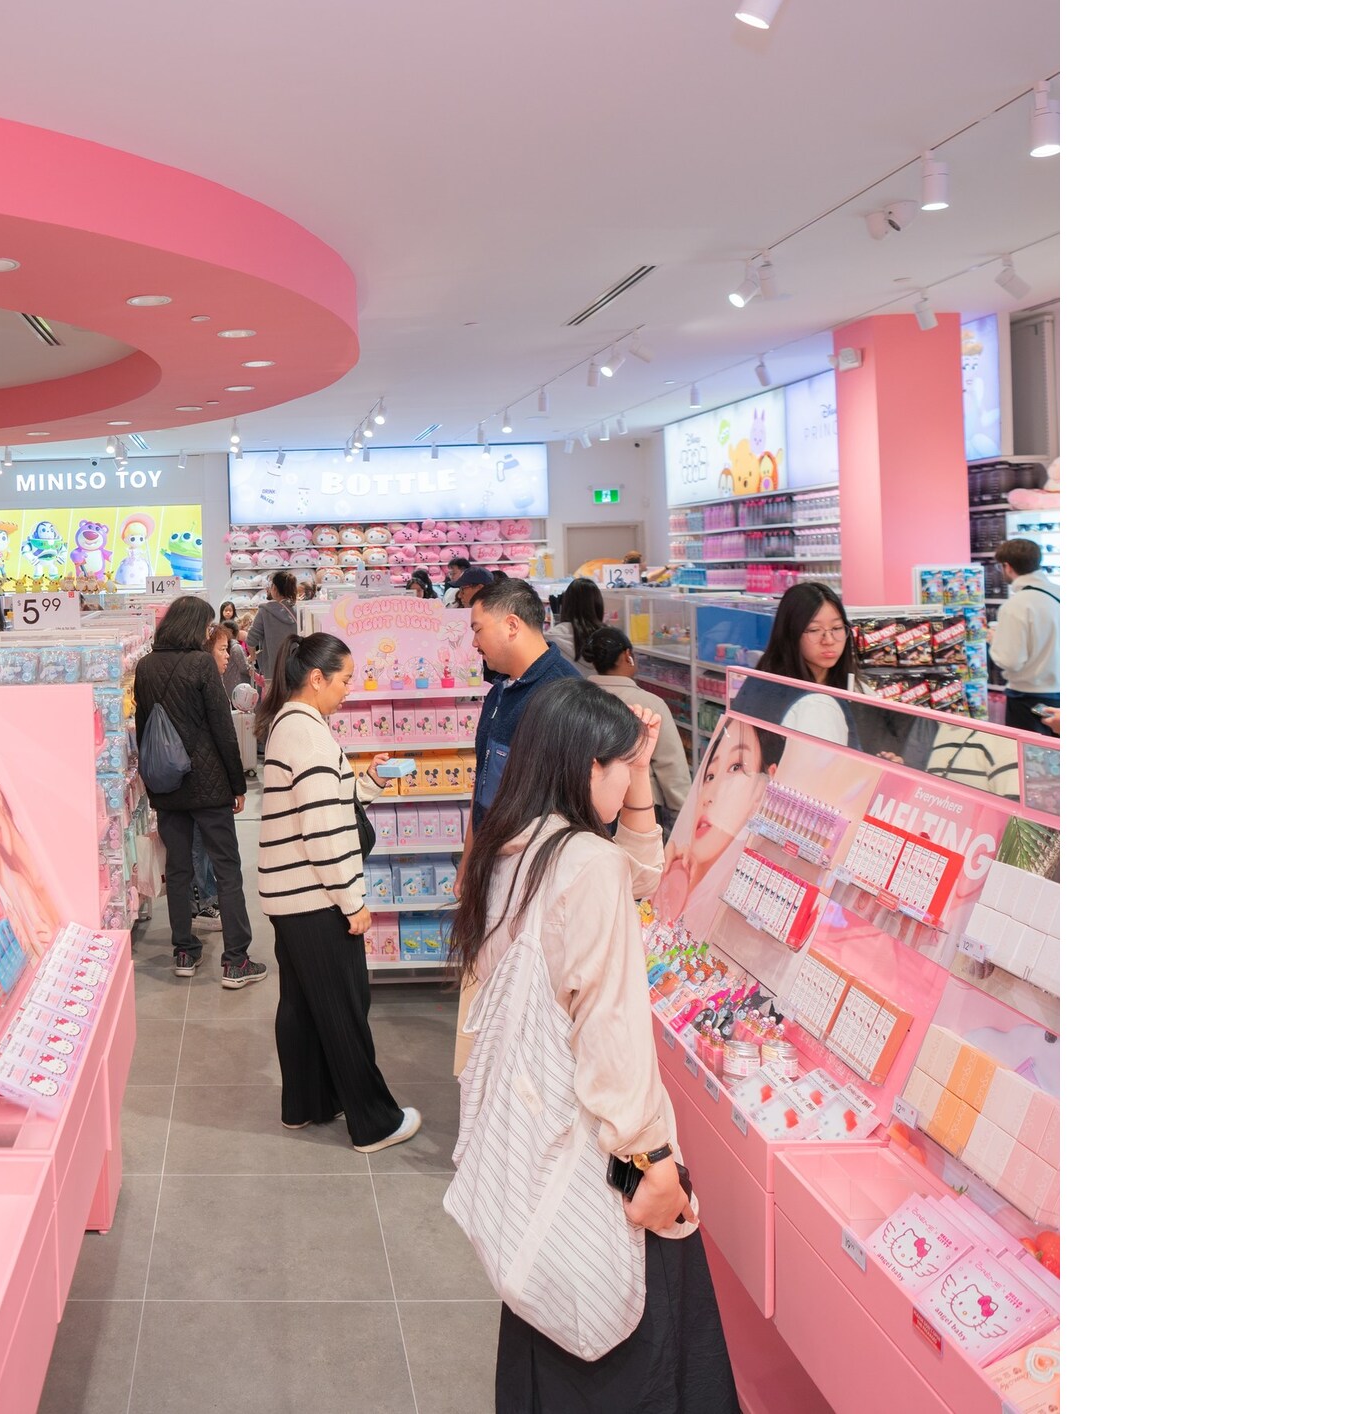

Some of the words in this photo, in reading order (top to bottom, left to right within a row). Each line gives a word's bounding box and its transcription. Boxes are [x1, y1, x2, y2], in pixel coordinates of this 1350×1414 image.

[16, 471, 106, 491] MINISO
[115, 470, 162, 489] TOY
[321, 469, 457, 496] BOTTLE
[353, 600, 433, 618] BEAUTIFUL
[346, 615, 393, 636] NIGHT
[396, 615, 441, 632] LIGHT
[914, 787, 963, 814] Everywhere
[869, 793, 996, 880] MELTING
[877, 1251, 892, 1269] angel
[890, 1266, 905, 1282] baby
[934, 1307, 953, 1325] angel
[950, 1323, 967, 1341] baby
